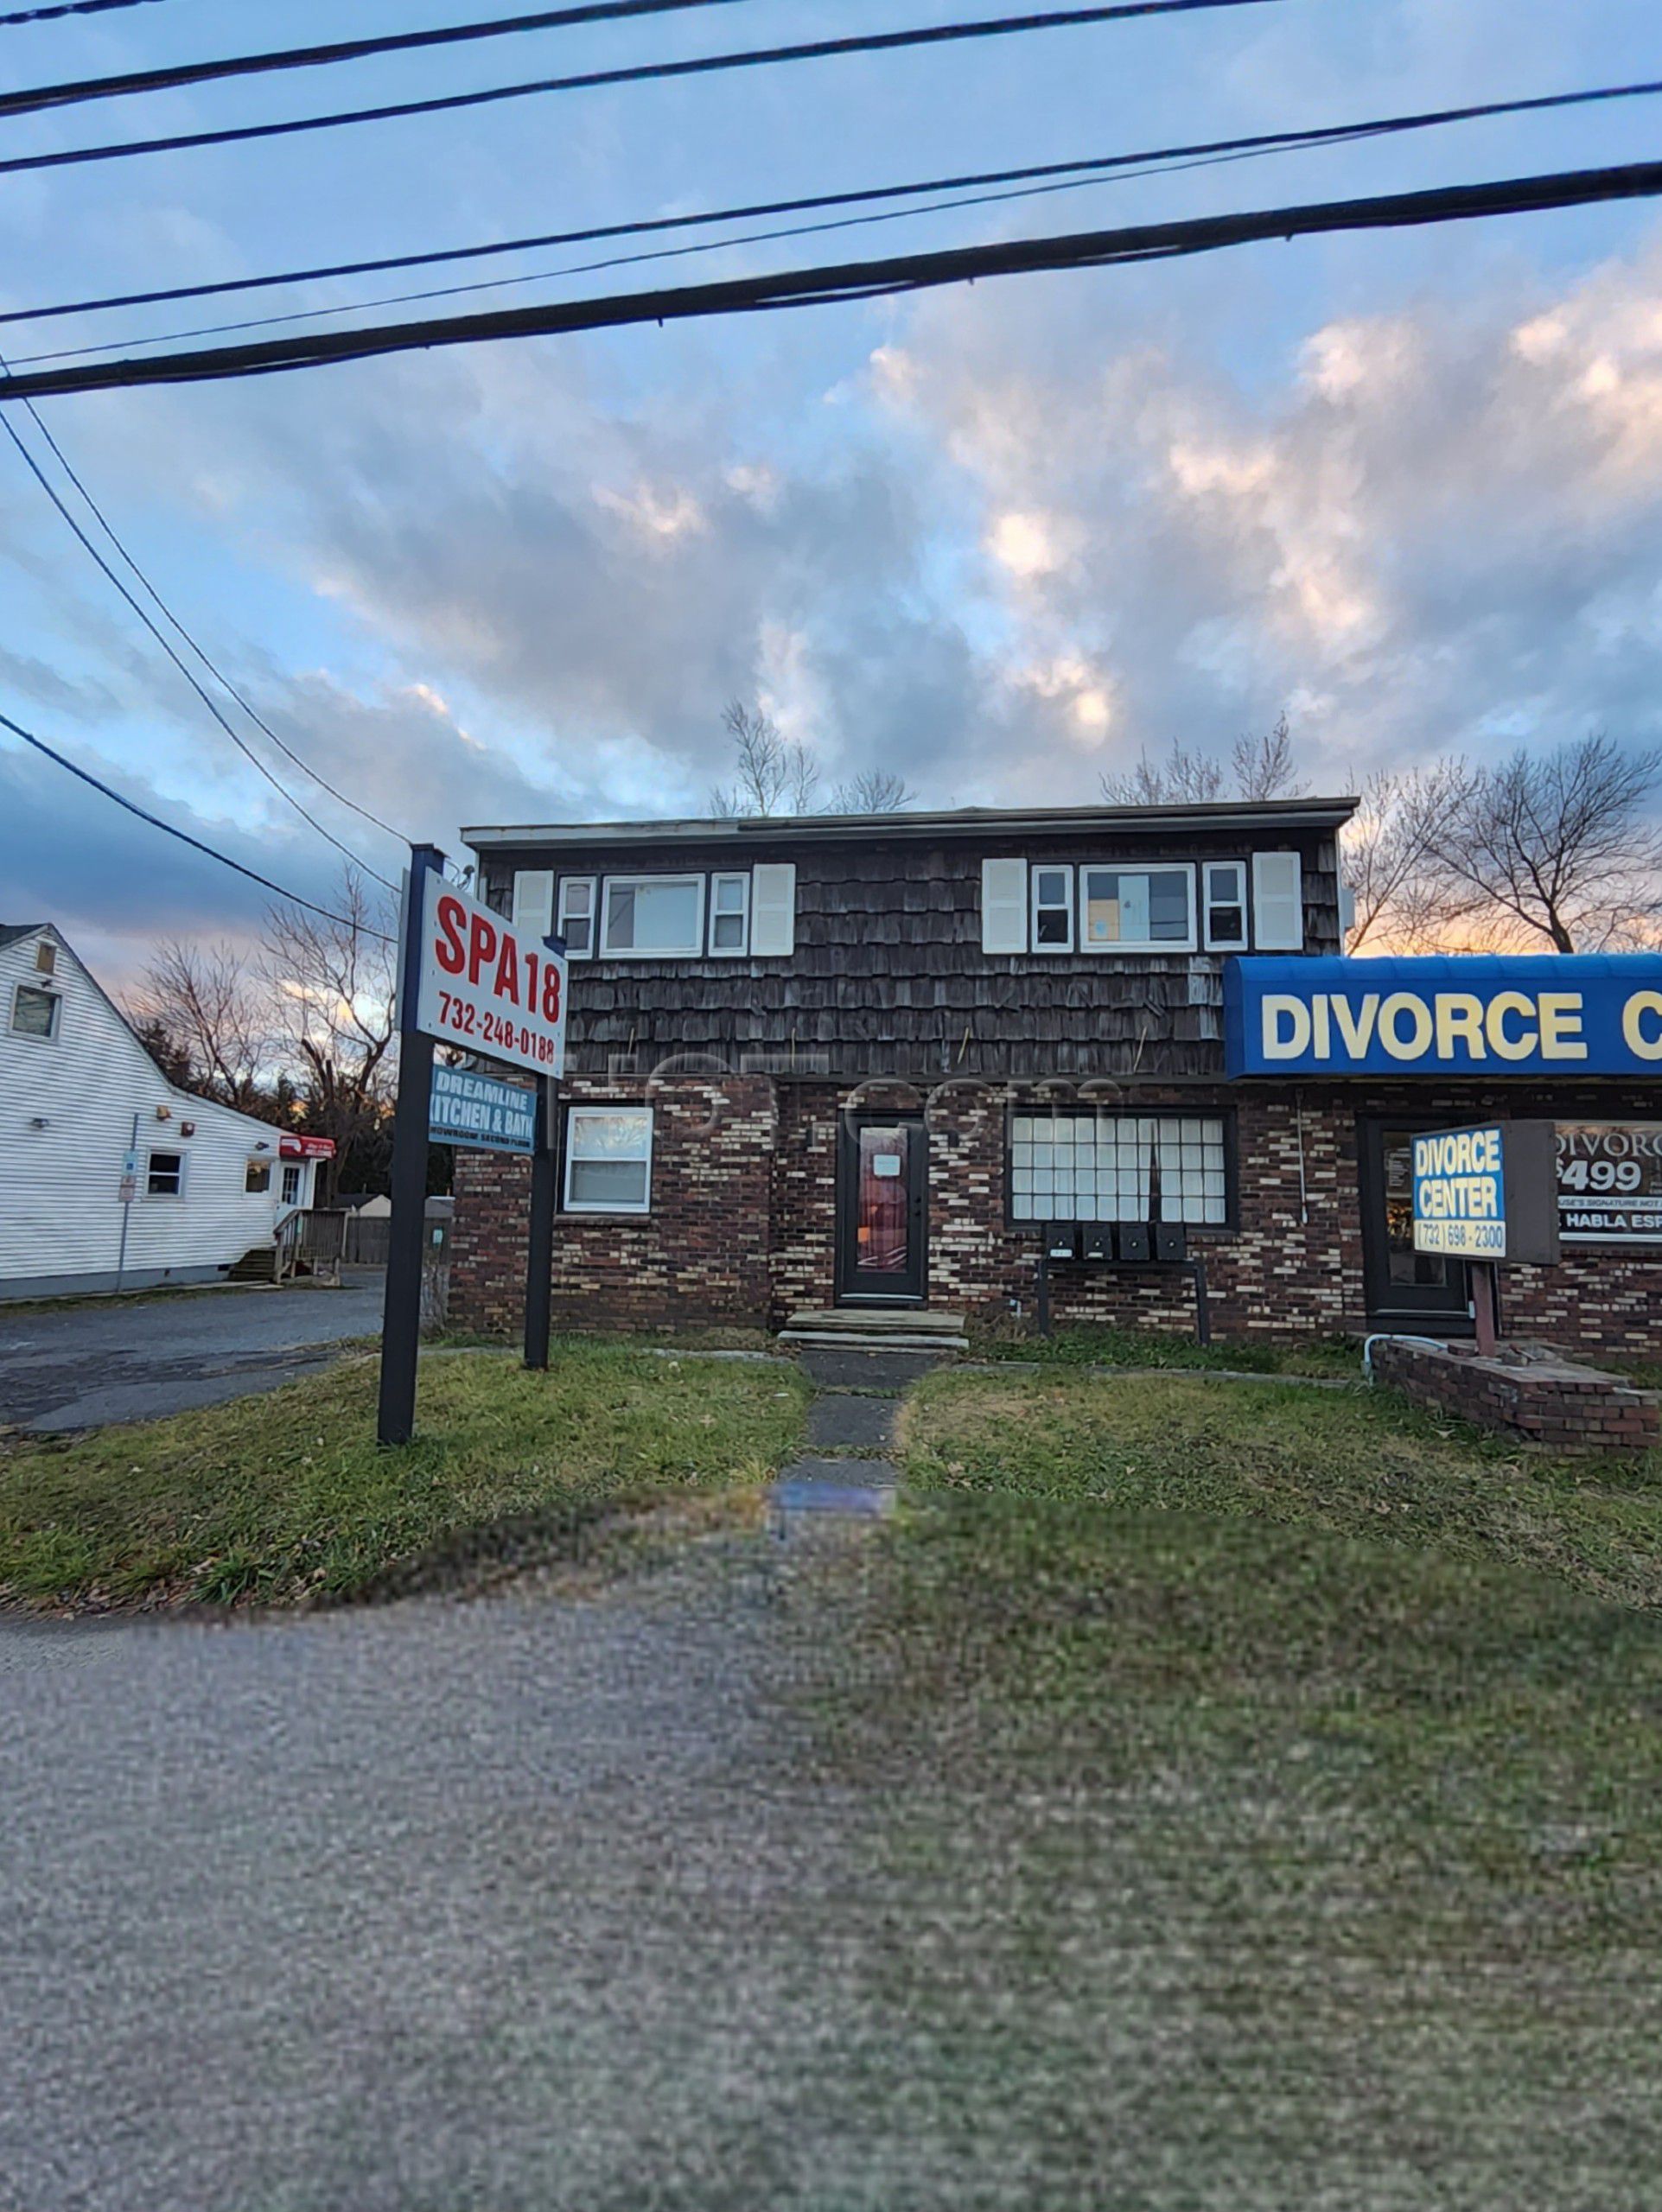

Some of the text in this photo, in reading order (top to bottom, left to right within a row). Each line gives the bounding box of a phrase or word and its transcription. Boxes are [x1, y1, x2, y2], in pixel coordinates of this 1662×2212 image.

[435, 895, 561, 1024] SPA18
[439, 990, 555, 1065] 732-248-0188
[1261, 991, 1589, 1061] DIVORCE
[436, 1071, 528, 1111] DREAMLINE
[492, 1108, 502, 1133] &
[504, 1109, 533, 1139] BATH
[1415, 1128, 1500, 1177] DIVORCE
[1419, 1177, 1498, 1217] CENTER
[1566, 1213, 1627, 1228] HABLA
